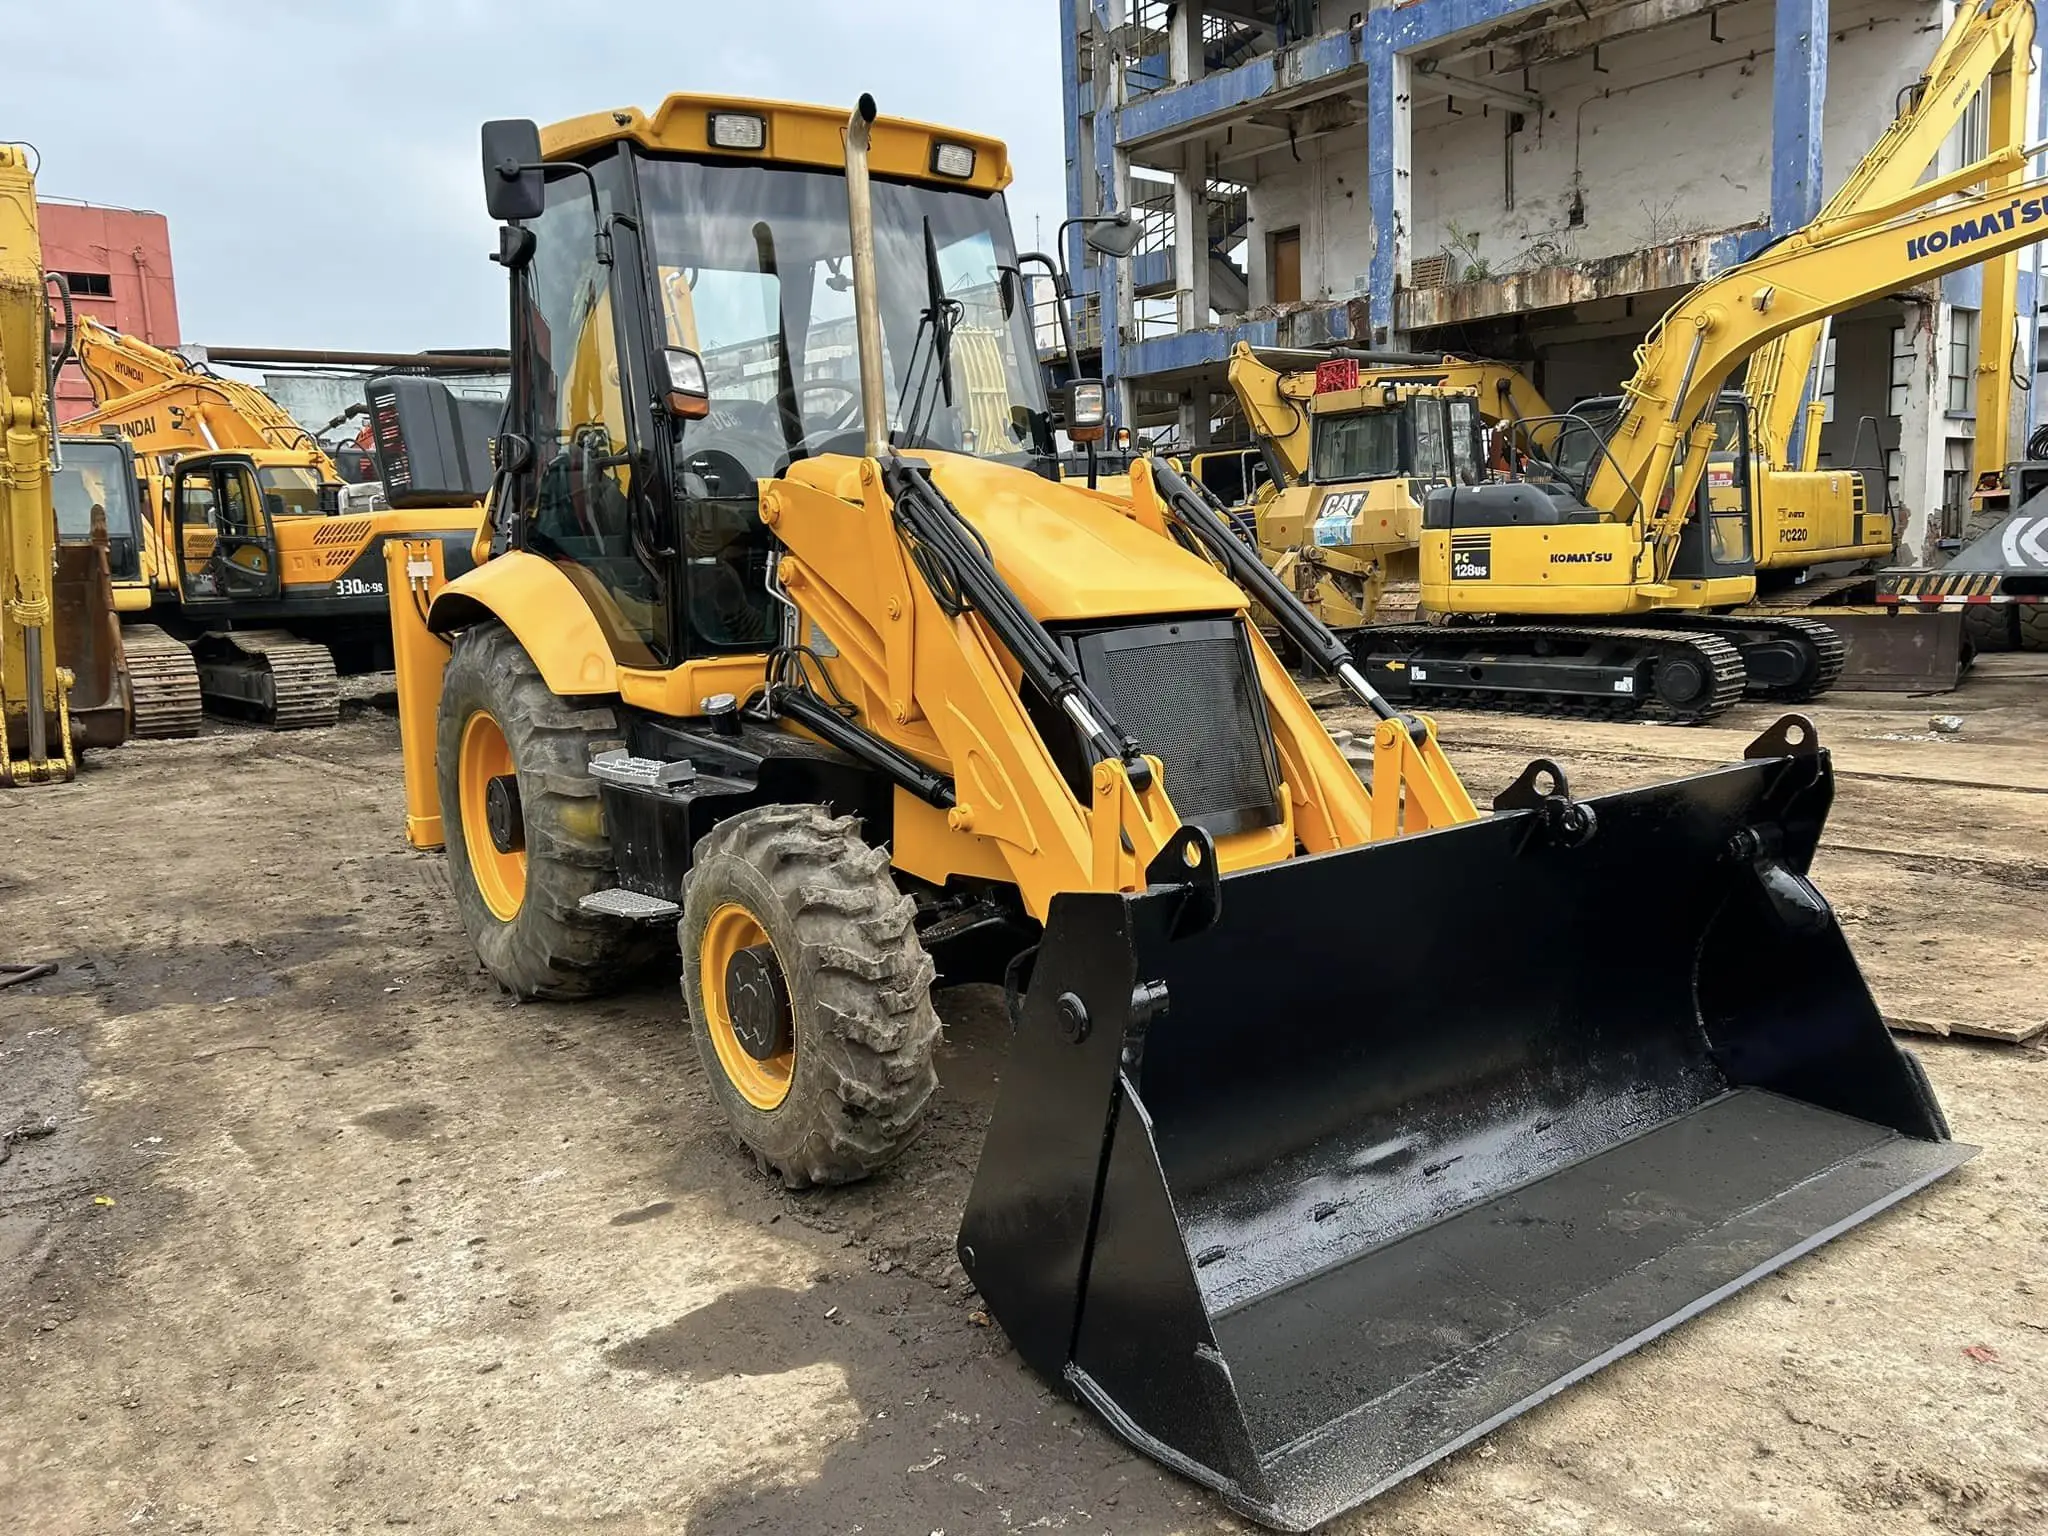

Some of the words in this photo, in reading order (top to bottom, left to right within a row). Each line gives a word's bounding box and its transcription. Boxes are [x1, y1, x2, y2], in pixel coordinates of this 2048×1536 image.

[114, 360, 144, 384] HYUNDAI
[1322, 493, 1363, 517] CAT
[1780, 528, 1808, 543] PC220
[1454, 552, 1470, 564] PC
[1550, 551, 1613, 563] KOMATSU
